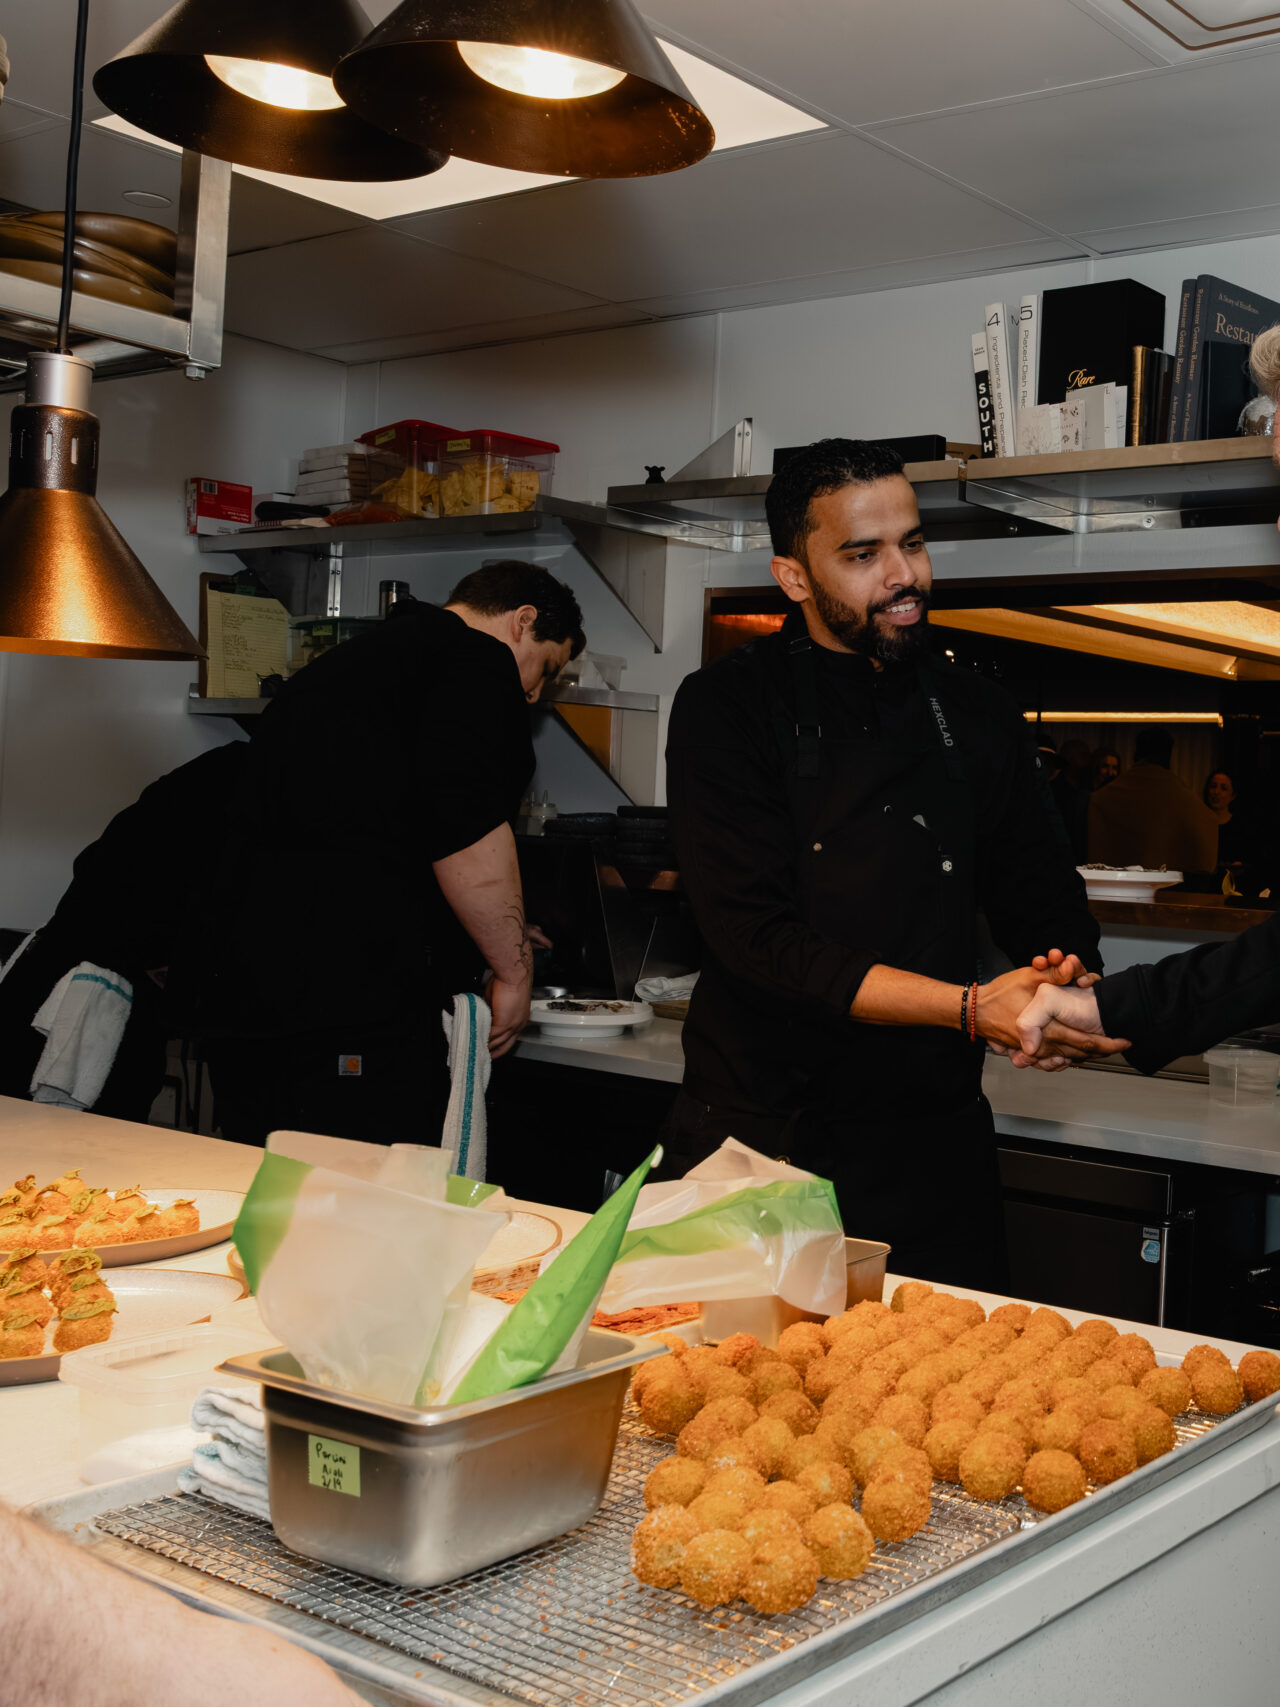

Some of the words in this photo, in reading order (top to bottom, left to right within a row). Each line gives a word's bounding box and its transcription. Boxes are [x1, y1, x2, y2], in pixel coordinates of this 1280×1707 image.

[987, 312, 1001, 327] 4
[1020, 305, 1033, 321] 5
[1066, 368, 1096, 389] Rare
[996, 393, 1004, 409] and
[978, 383, 993, 453] SOUTH
[929, 697, 954, 747] HEXCLAD
